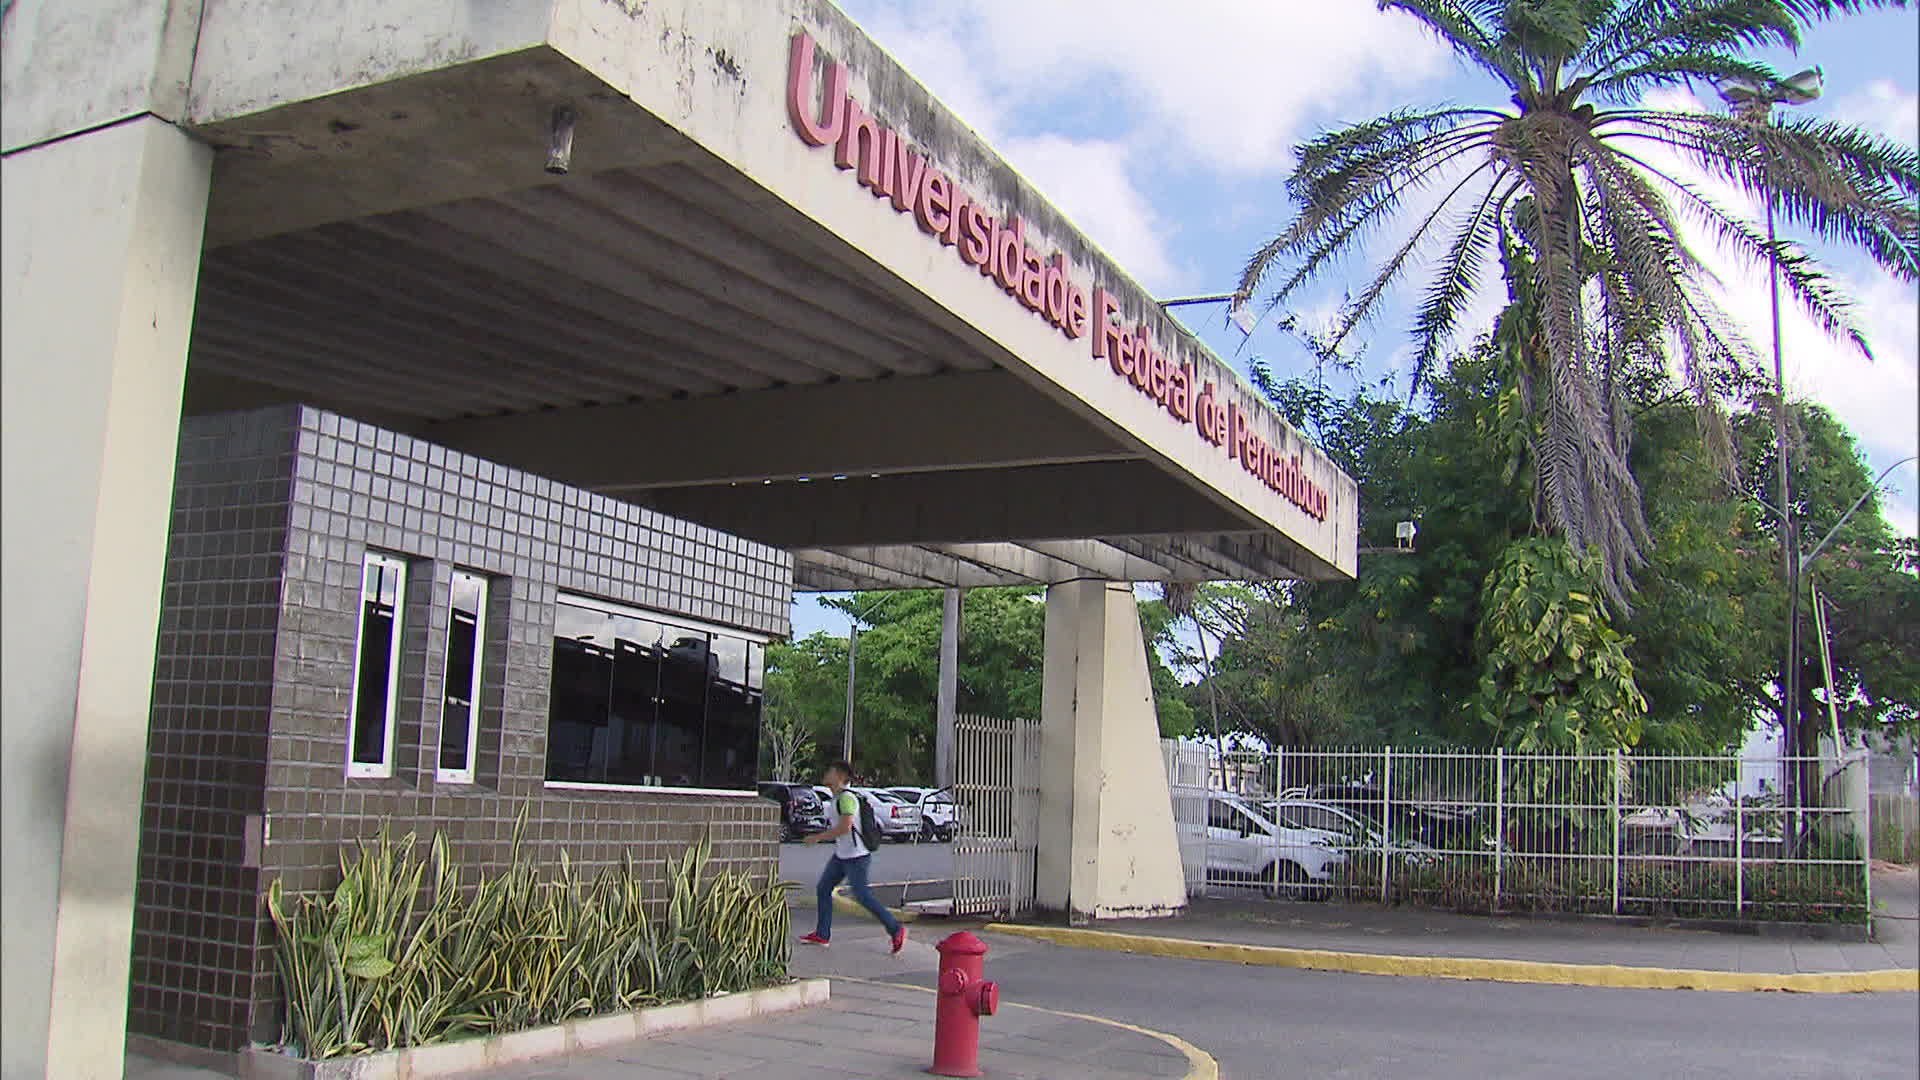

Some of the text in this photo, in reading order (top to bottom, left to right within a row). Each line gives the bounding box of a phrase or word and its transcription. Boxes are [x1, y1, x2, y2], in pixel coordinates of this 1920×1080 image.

[787, 33, 1328, 523] Universidade Federal de Pernambuco
